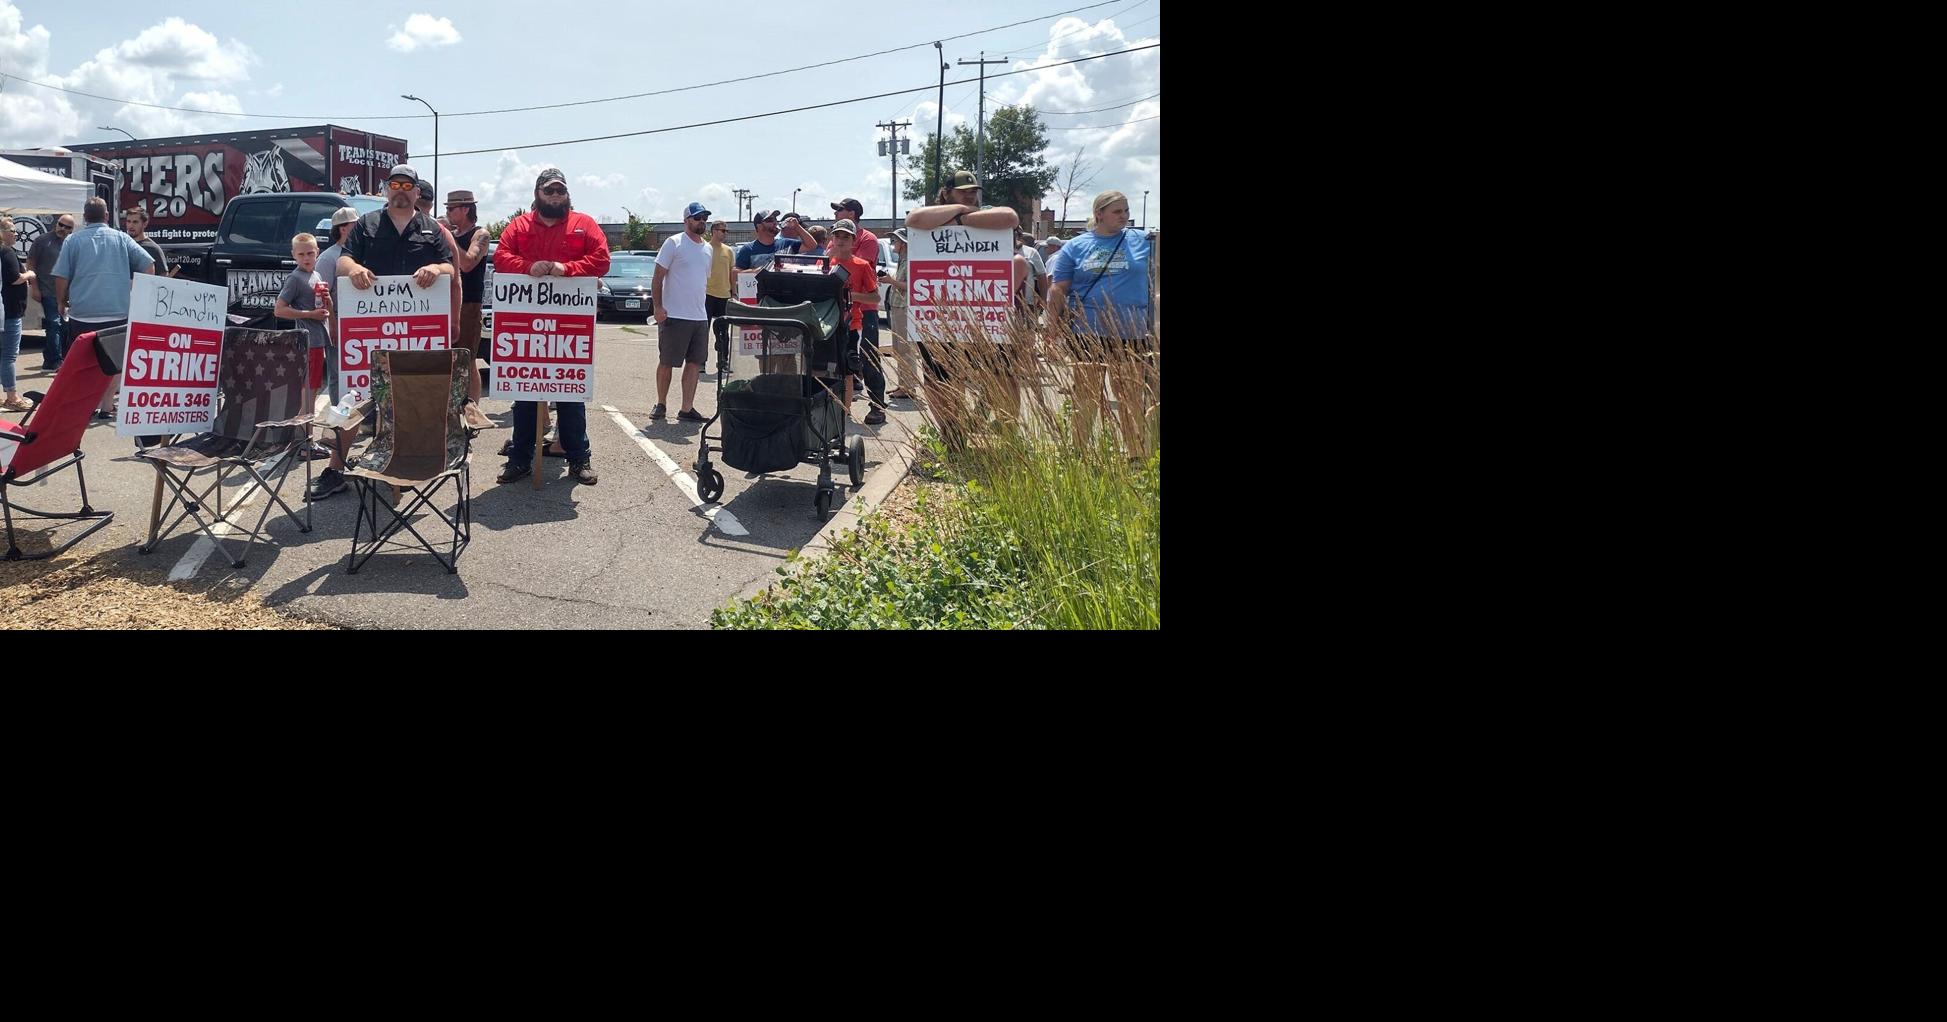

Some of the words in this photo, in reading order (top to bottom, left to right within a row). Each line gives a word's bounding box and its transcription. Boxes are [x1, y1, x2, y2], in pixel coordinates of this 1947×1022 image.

[339, 144, 400, 168] TEAMSTERS
[348, 158, 374, 167] LOCAL
[377, 161, 391, 169] 120
[162, 229, 182, 239] fight
[182, 230, 191, 238] to
[936, 240, 999, 254] BLANDIN
[947, 264, 973, 277] ON
[374, 282, 414, 298] UPM
[495, 282, 533, 304] UPM
[537, 282, 594, 306] Blandin
[913, 278, 1009, 303] STRIKE
[194, 292, 217, 304] UPM
[356, 299, 431, 314] BLANDIN
[382, 321, 408, 335] ON
[532, 318, 557, 332] ON
[168, 332, 192, 349] ON
[496, 332, 590, 359] STRIKE
[129, 349, 218, 382] STRIKE
[497, 366, 551, 380] LOCAL
[555, 368, 586, 380] 346
[496, 381, 513, 392] I.B.
[516, 382, 586, 394] TEAMSTERS
[127, 392, 181, 408] LOCAL
[184, 393, 211, 408] 346
[125, 411, 142, 425] I.B.
[146, 410, 209, 424] TEAMSTERS
